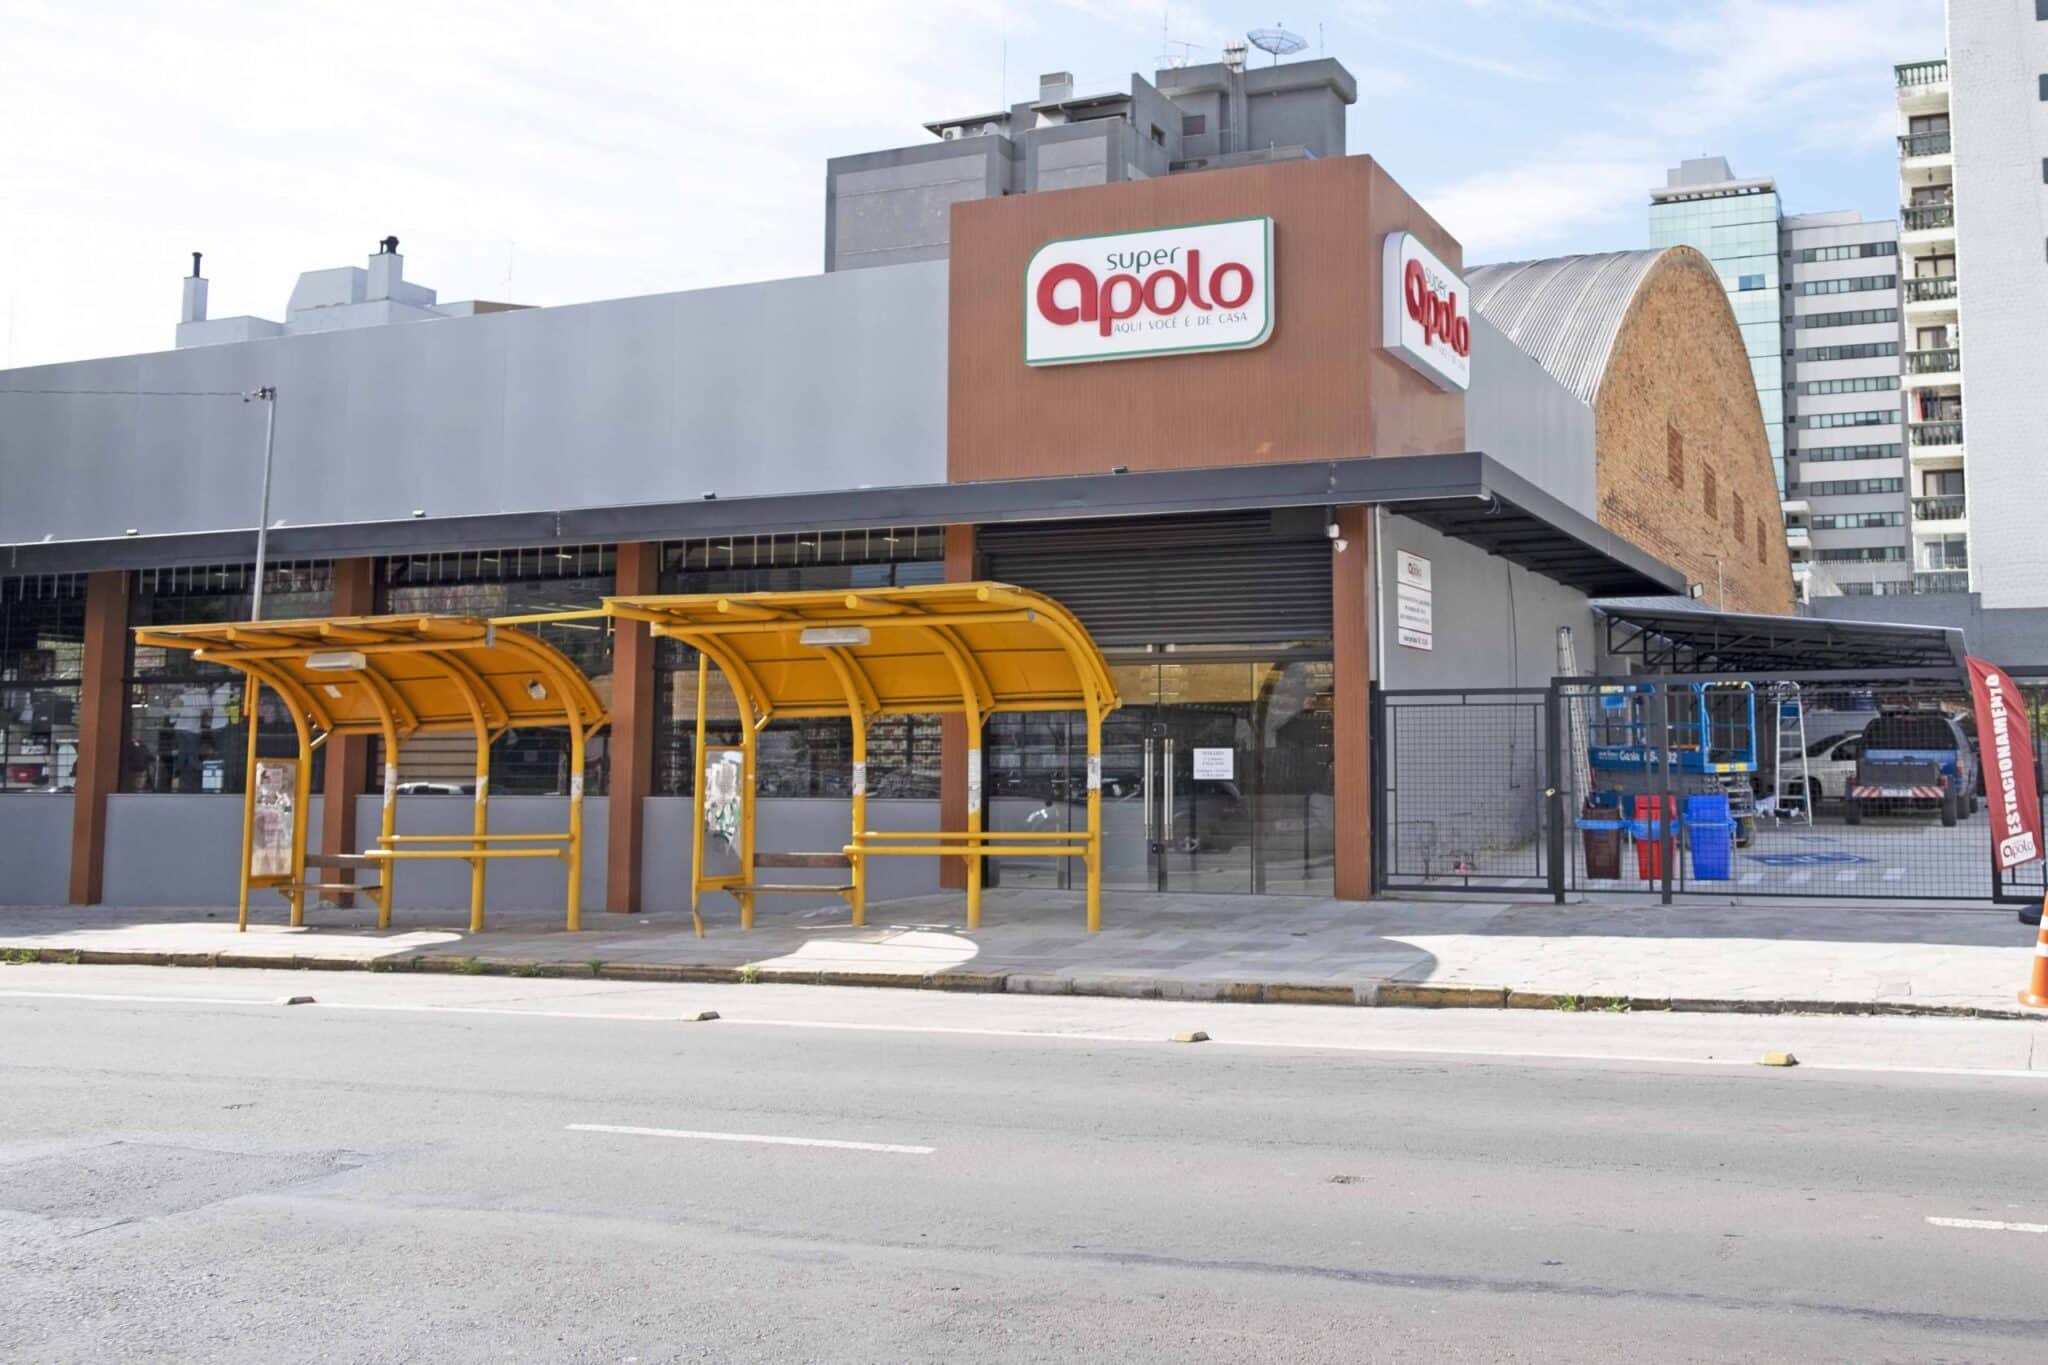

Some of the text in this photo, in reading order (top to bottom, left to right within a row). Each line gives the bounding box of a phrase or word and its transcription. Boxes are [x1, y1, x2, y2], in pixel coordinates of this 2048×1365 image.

[1036, 249, 1254, 337] apolo
[1106, 246, 1181, 274] super
[1114, 311, 1248, 335] AQUI VOCÊ É DE CASA
[1405, 258, 1471, 357] apolo
[1985, 674, 2022, 836] ESTACIONAMENTO
